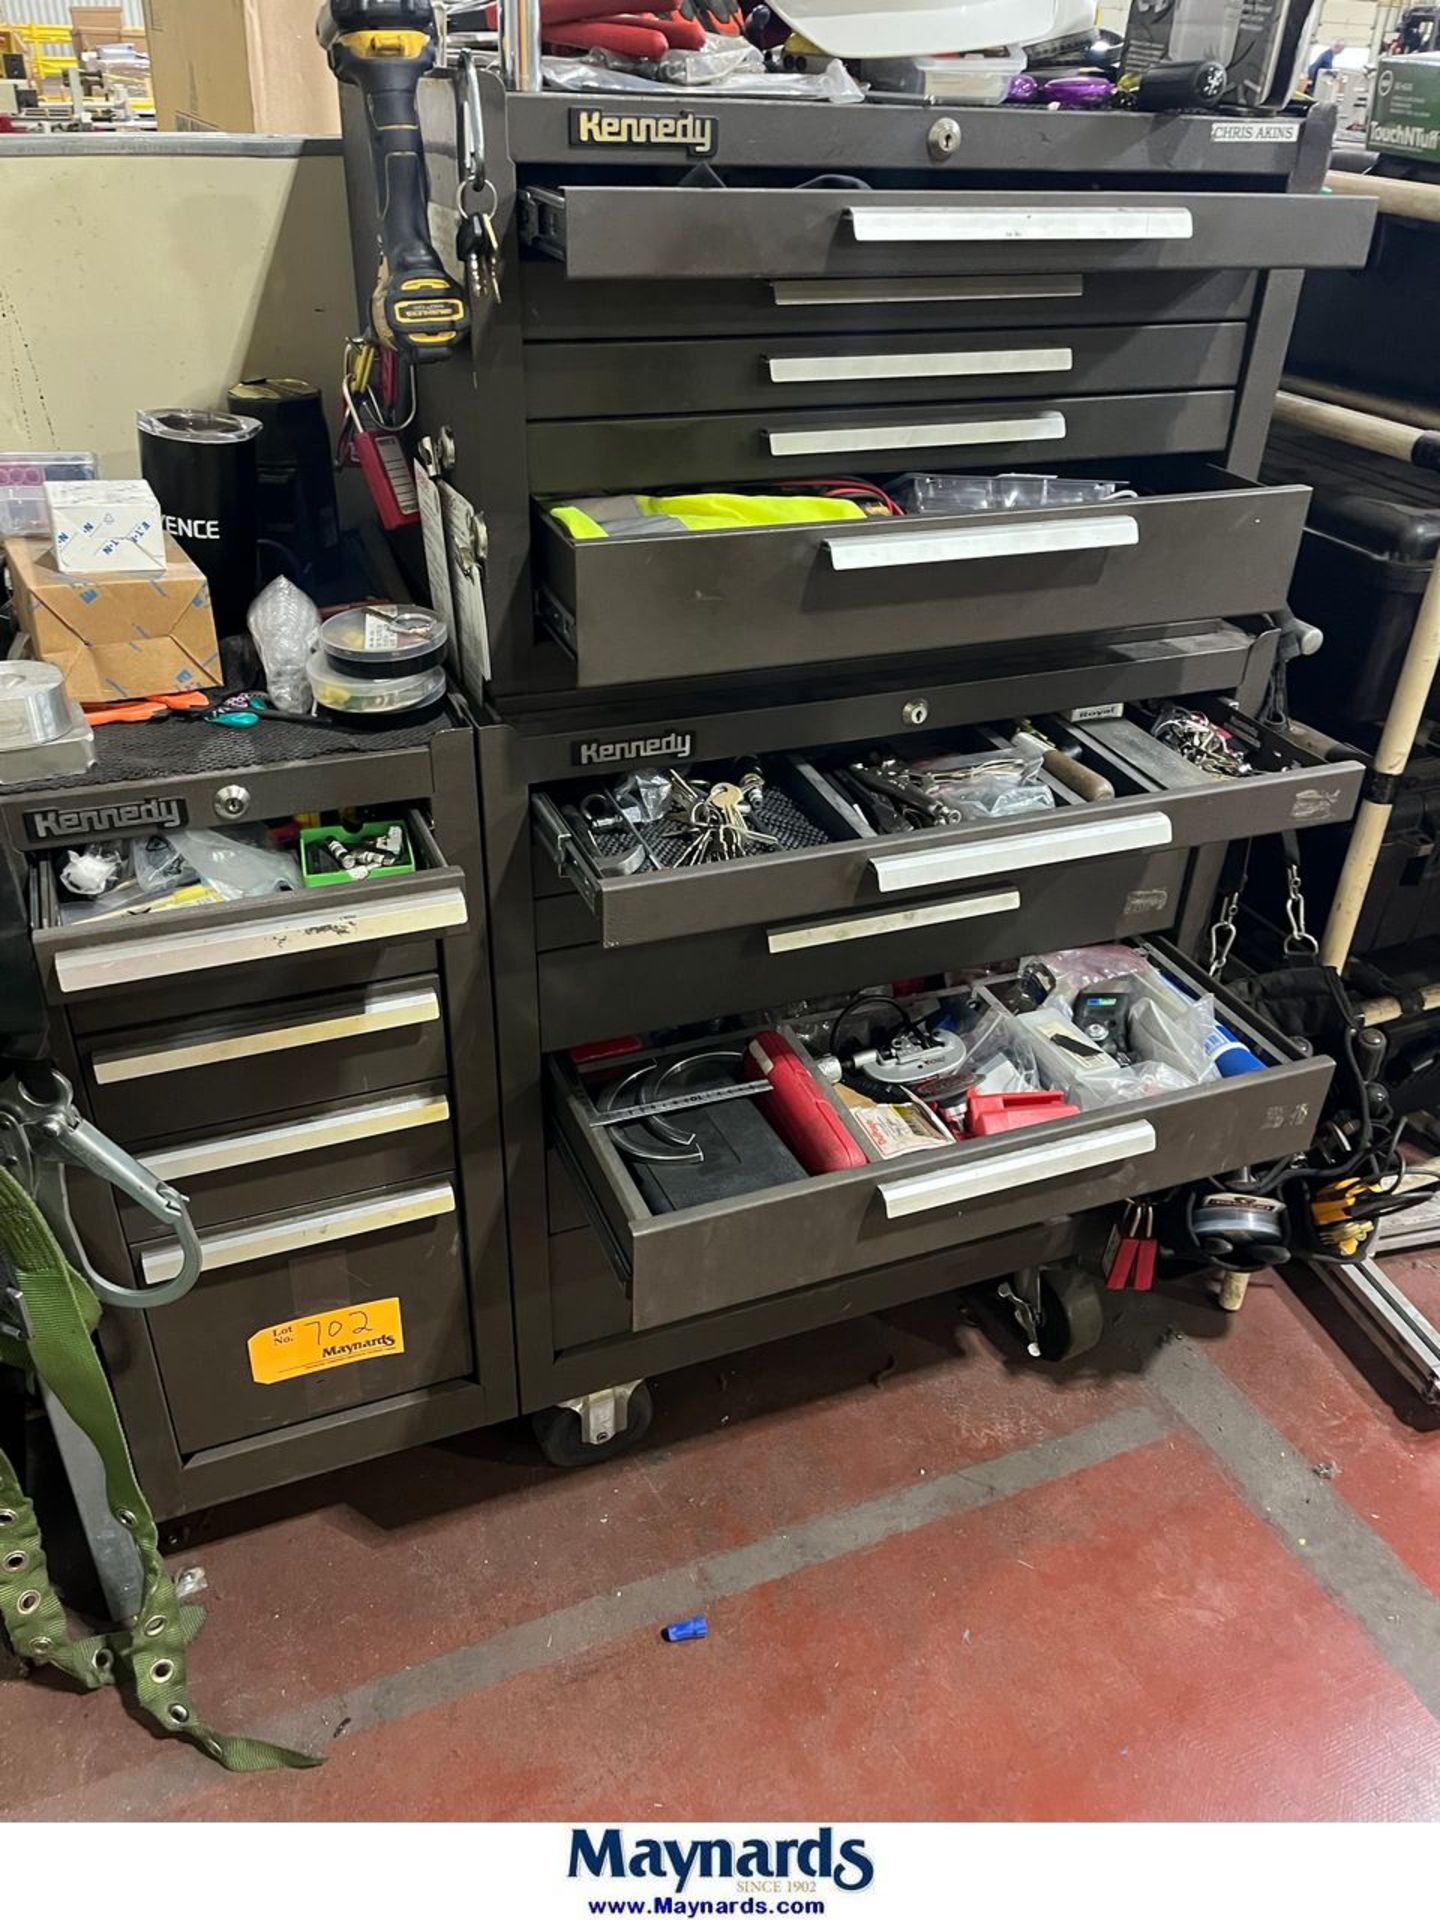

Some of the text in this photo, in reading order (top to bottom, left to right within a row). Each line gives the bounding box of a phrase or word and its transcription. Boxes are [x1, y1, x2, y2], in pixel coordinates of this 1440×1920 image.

[579, 111, 711, 152] Kennedy
[1213, 126, 1295, 139] CHRIS AKINS
[581, 733, 691, 765] Kennedy
[33, 799, 181, 838] Kennedy
[272, 1325, 293, 1338] Lot
[273, 1336, 294, 1347] No.
[304, 1310, 373, 1346] 702
[322, 1334, 396, 1359] Maynards
